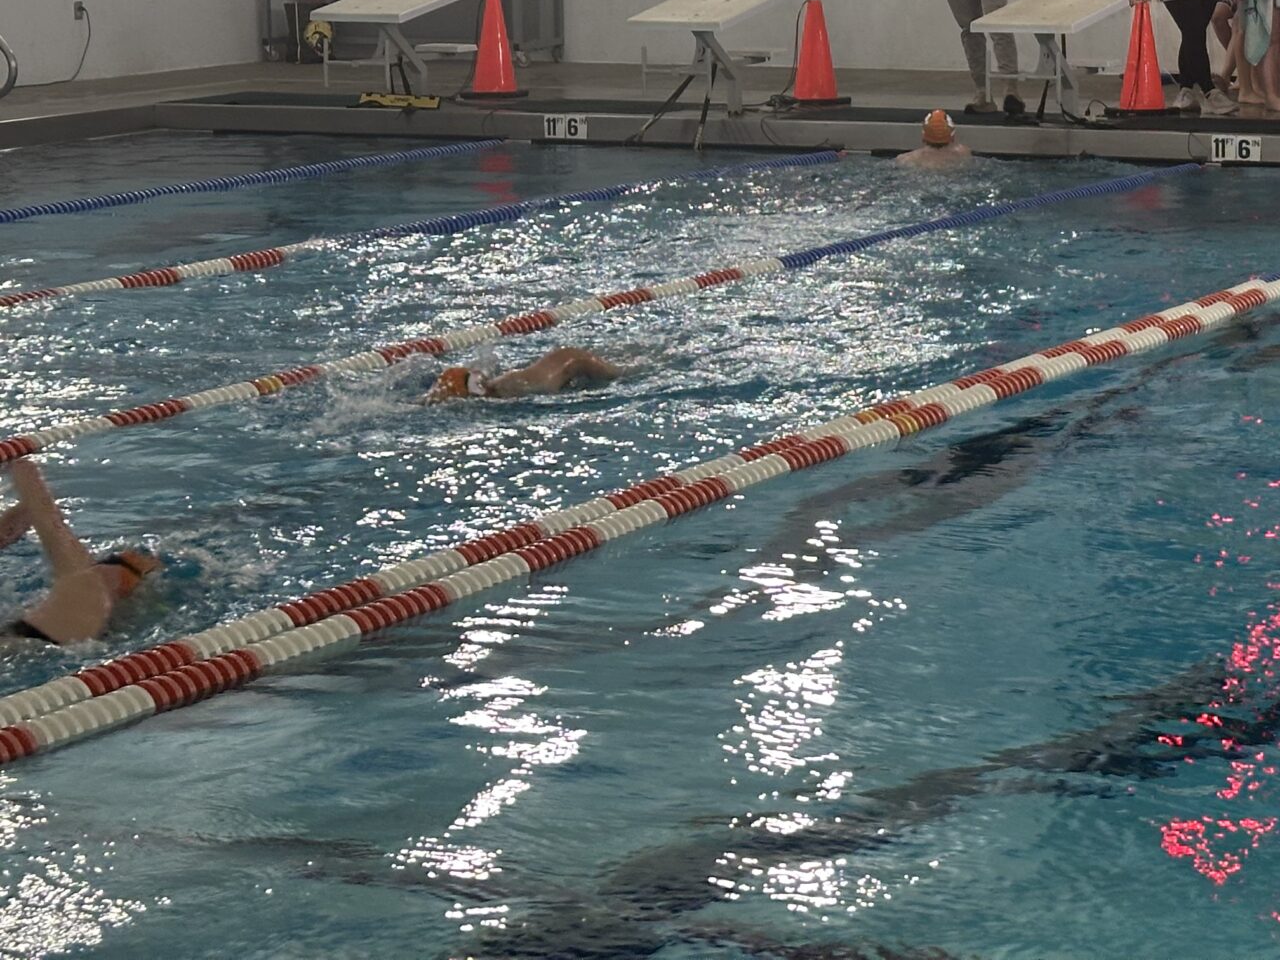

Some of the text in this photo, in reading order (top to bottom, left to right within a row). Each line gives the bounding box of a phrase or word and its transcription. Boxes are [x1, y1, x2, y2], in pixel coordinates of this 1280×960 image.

[545, 117, 556, 136] 11
[567, 118, 579, 136] 6
[1213, 137, 1226, 158] 11
[1238, 139, 1250, 159] 6
